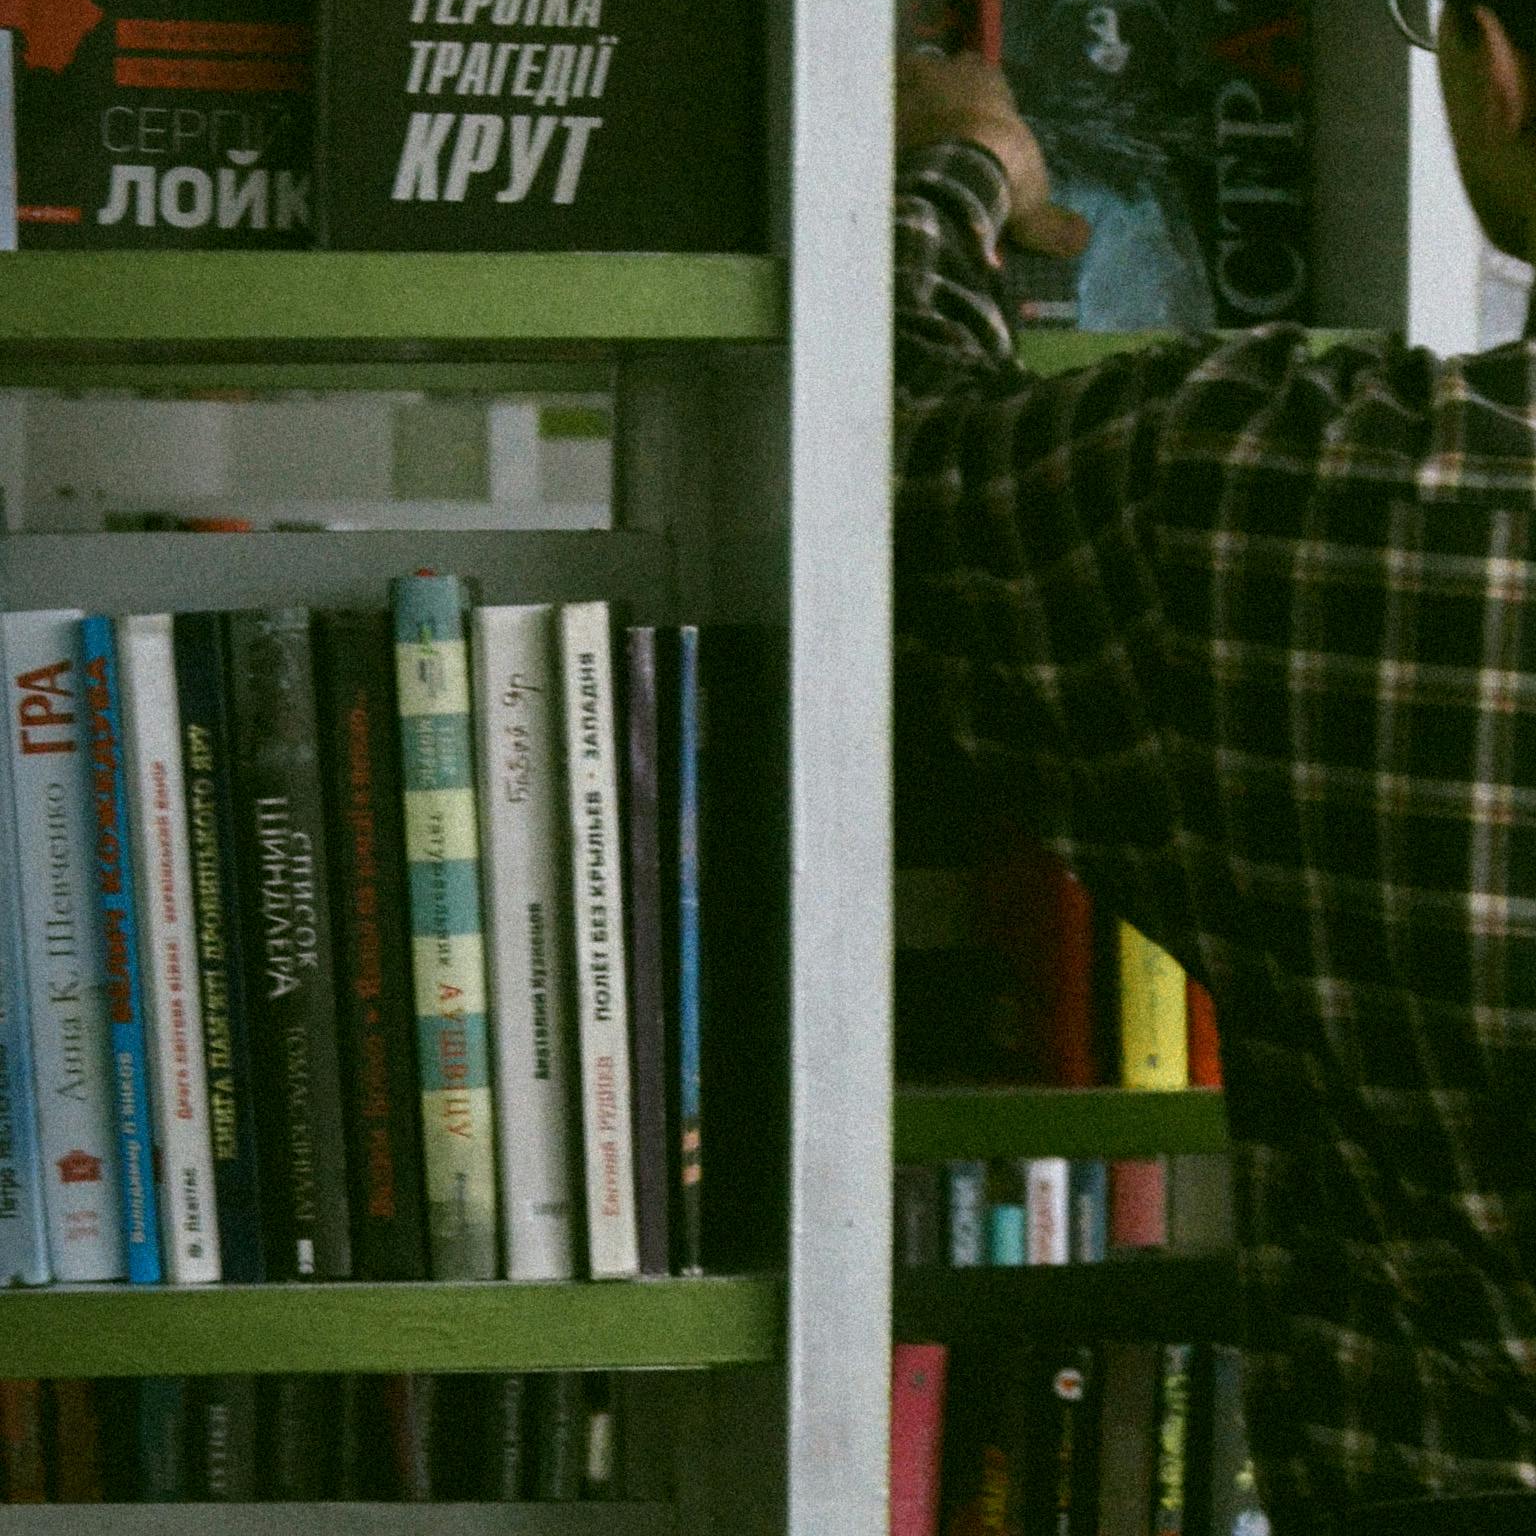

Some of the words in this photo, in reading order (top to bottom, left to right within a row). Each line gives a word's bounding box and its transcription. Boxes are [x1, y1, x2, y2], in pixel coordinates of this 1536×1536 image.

[405, 35, 618, 107] ТРАГЕДІЇ
[391, 113, 603, 206] КРУТ
[16, 657, 78, 756] ГРА
[579, 651, 602, 761] ЗАПАДНЯ
[45, 782, 77, 957] Шевченко
[584, 789, 606, 897] КРЫЛЬЕВ
[256, 795, 301, 1002] ШИНДЛЕРА
[291, 830, 318, 968] СПИСОК
[586, 904, 608, 943] БЕЗ
[48, 969, 82, 1004] К.
[56, 1017, 87, 1101] Анна
[438, 982, 473, 1140] АУШВІЦУ
[212, 1075, 239, 1160] КНИГА
